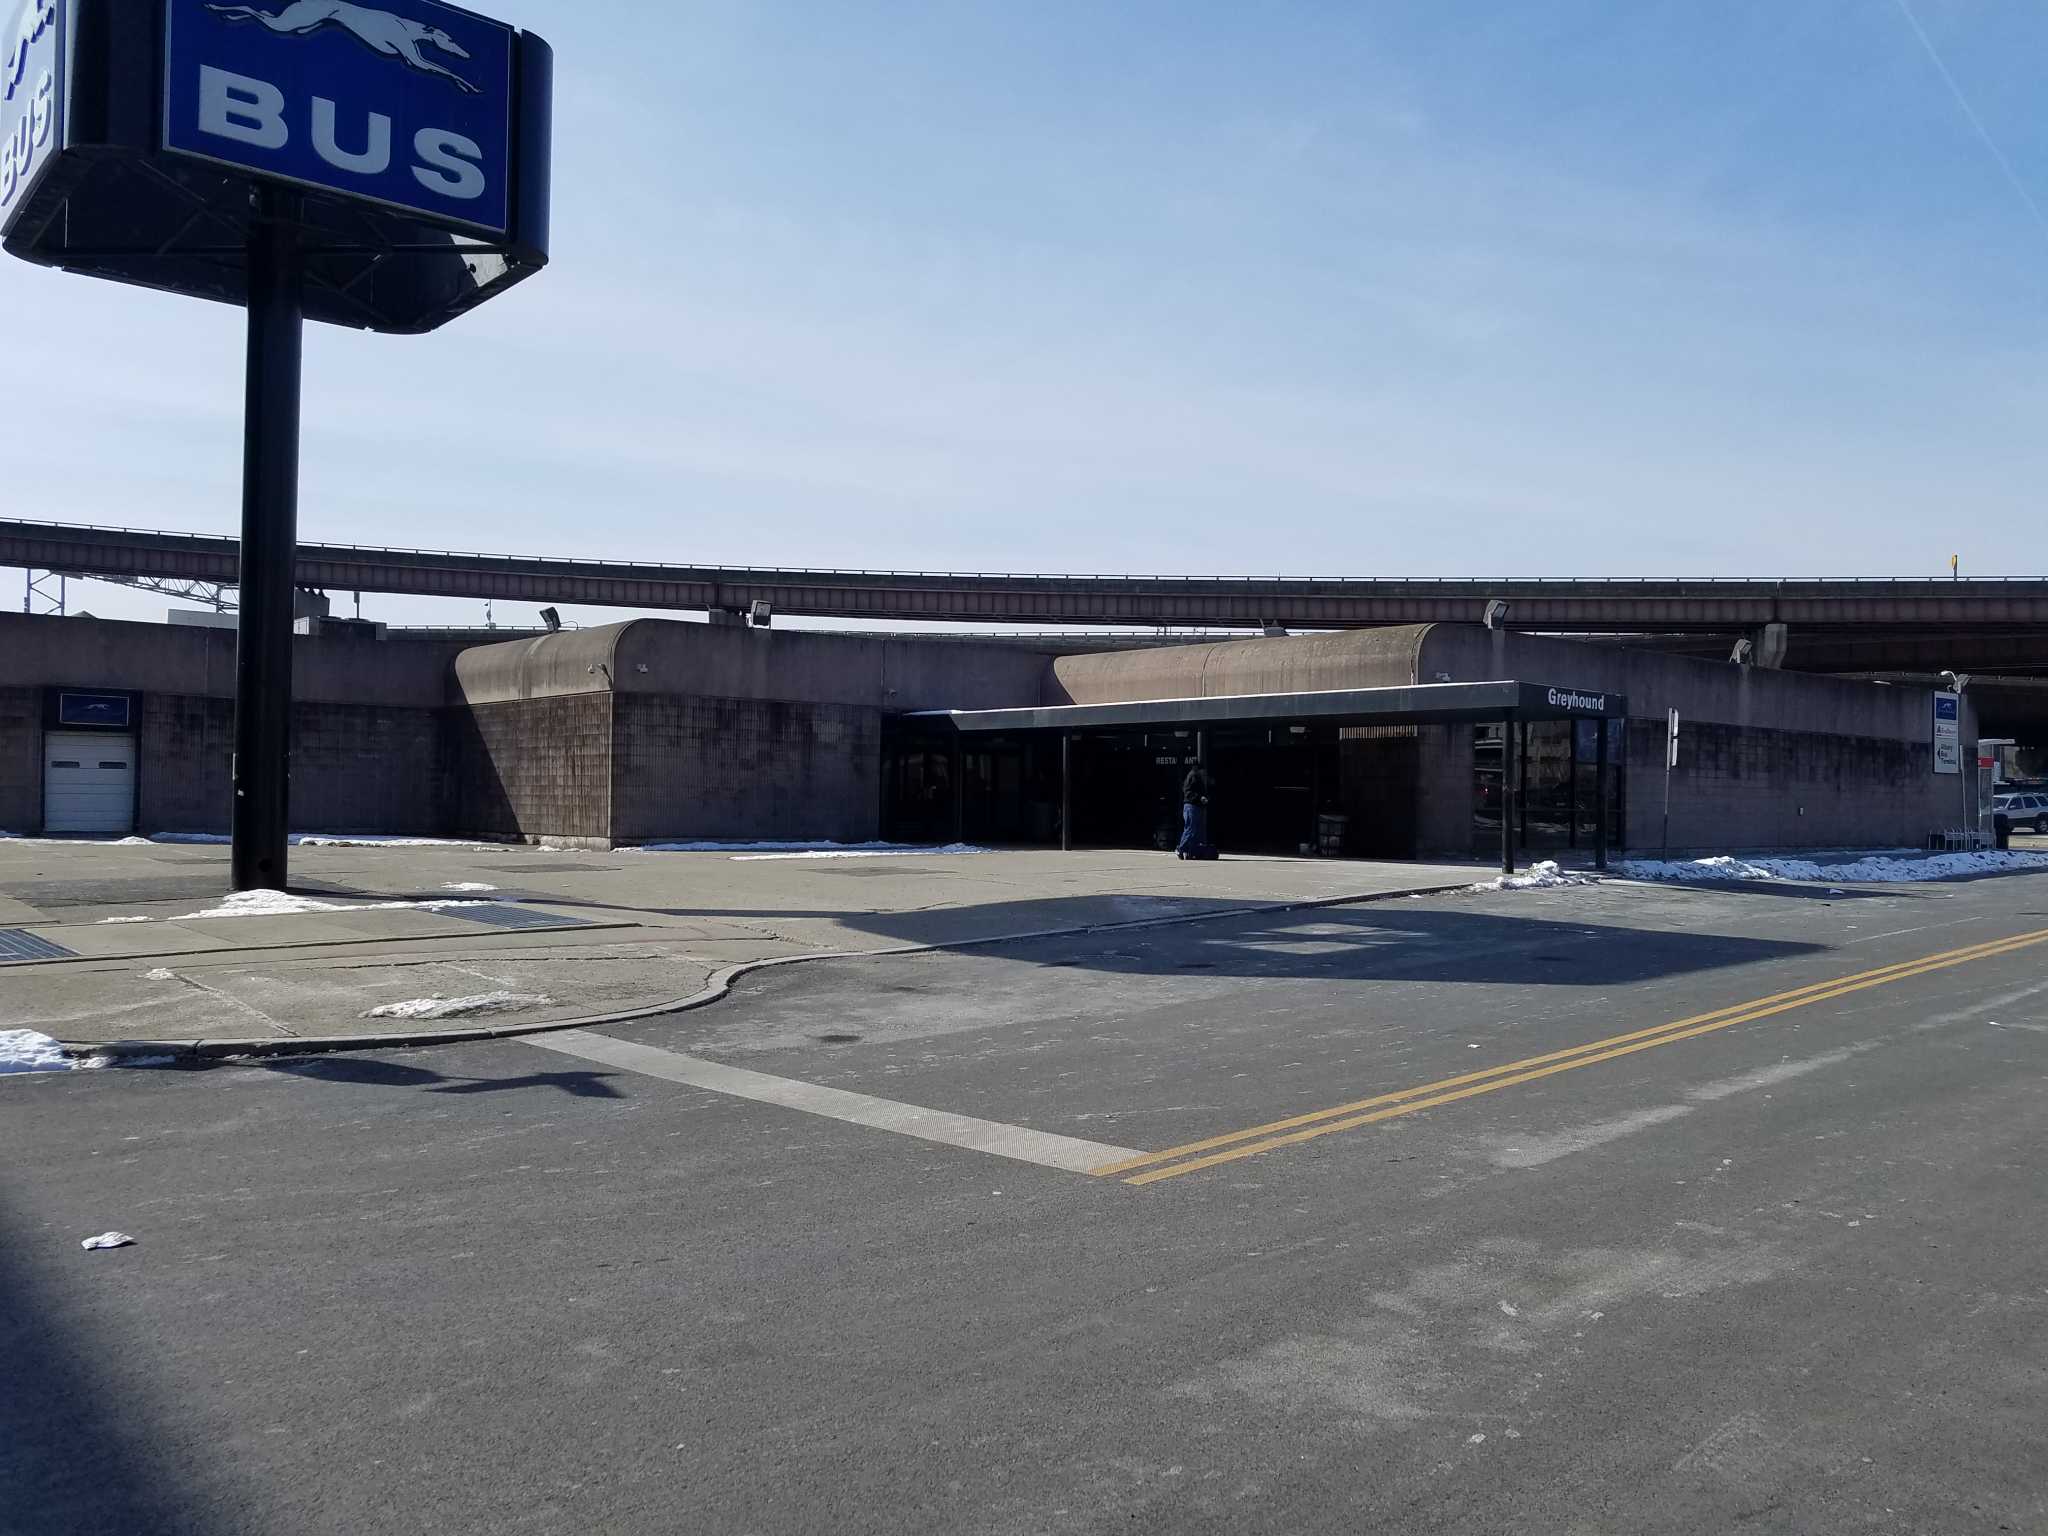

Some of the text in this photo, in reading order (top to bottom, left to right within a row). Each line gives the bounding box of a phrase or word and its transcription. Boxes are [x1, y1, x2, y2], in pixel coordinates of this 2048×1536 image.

[1, 70, 51, 206] BUS
[198, 64, 486, 199] BUS
[1548, 688, 1604, 710] Greyhound
[1155, 756, 1198, 765] RESTAANT
